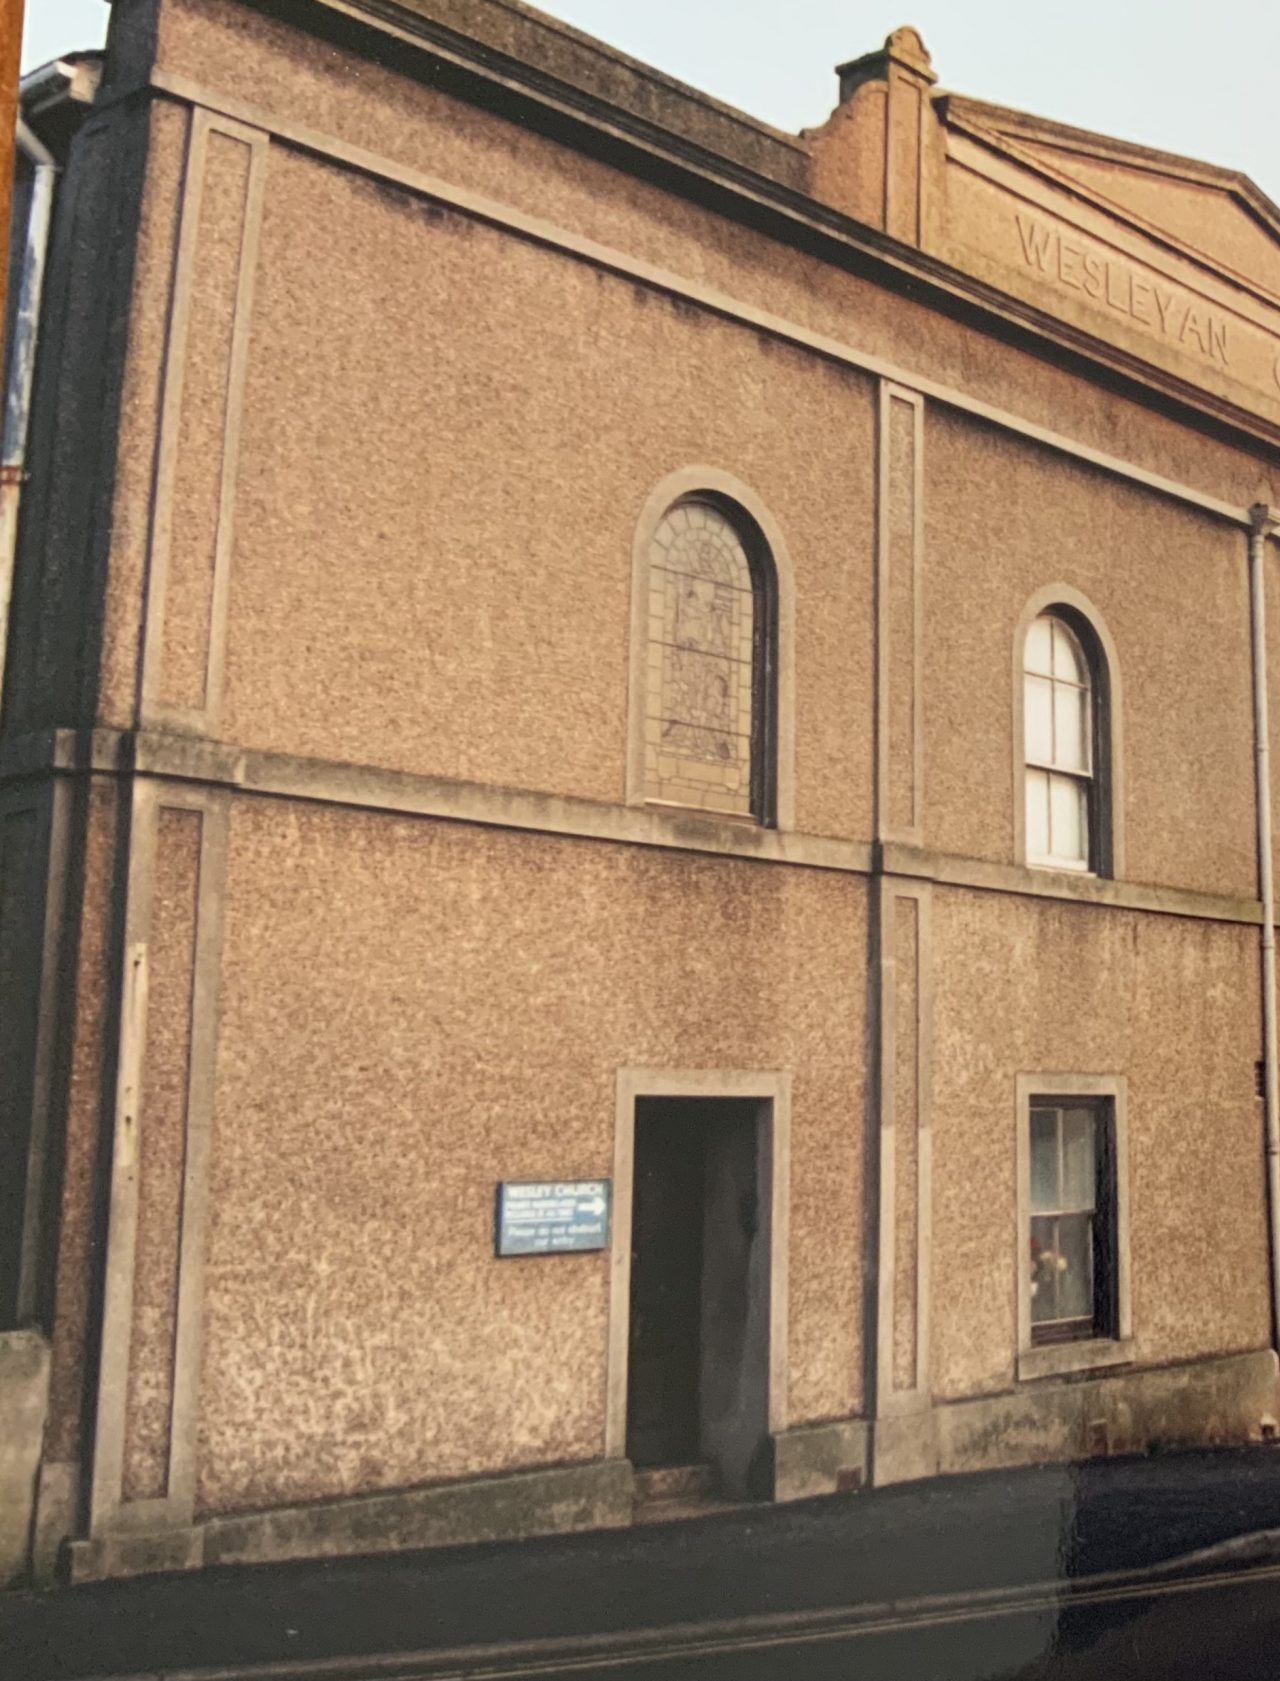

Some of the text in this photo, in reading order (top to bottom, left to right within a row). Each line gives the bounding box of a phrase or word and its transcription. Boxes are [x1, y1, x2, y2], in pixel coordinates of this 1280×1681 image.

[1014, 214, 1230, 366] WESLEYAN
[508, 1183, 604, 1198] WESLEY CHURCH
